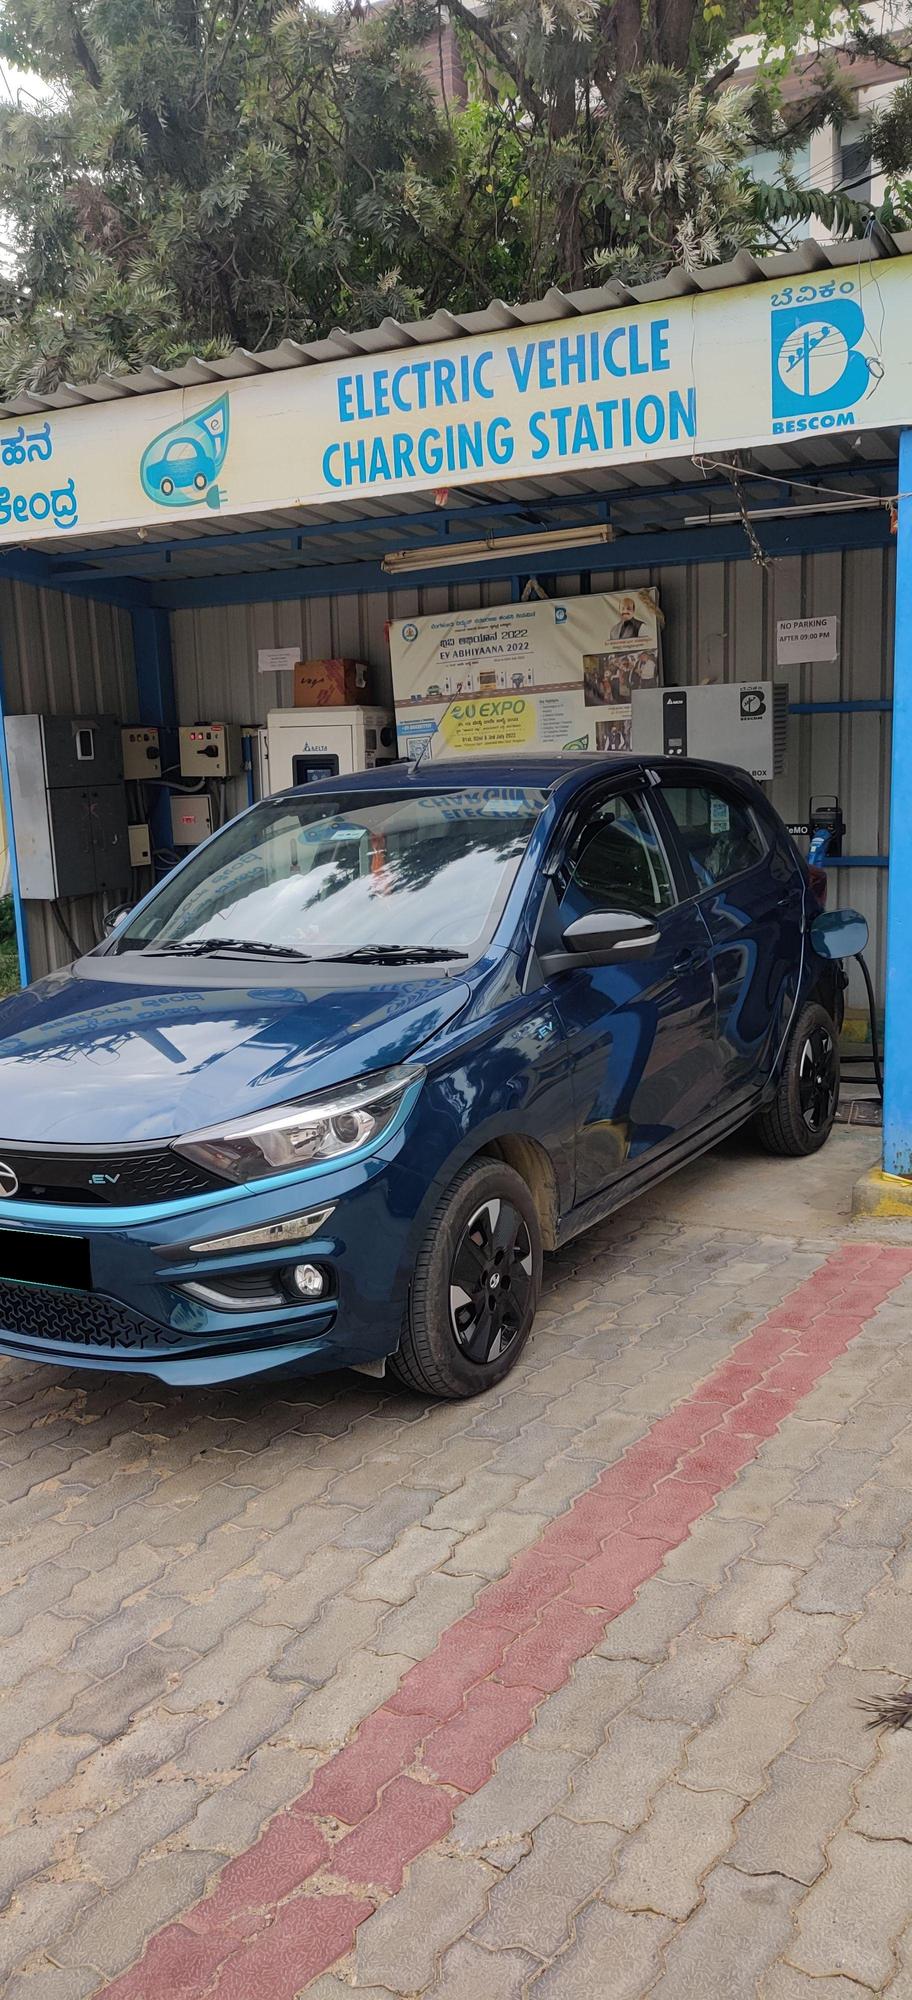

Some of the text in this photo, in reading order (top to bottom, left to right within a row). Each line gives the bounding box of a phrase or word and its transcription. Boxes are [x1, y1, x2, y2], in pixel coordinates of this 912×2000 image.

[771, 279, 855, 307] ಬೆವಿಕಂ
[337, 318, 671, 423] ELECTRIC VEHICLE
[772, 411, 855, 435] BESCOM
[322, 387, 696, 488] CHARGING STATION
[780, 619, 827, 630] NO PARKING
[501, 629, 528, 640] 2022
[780, 634, 798, 642] AFTER
[440, 642, 529, 660] EV ABHIYAANA 2022
[479, 699, 526, 718] EXPO
